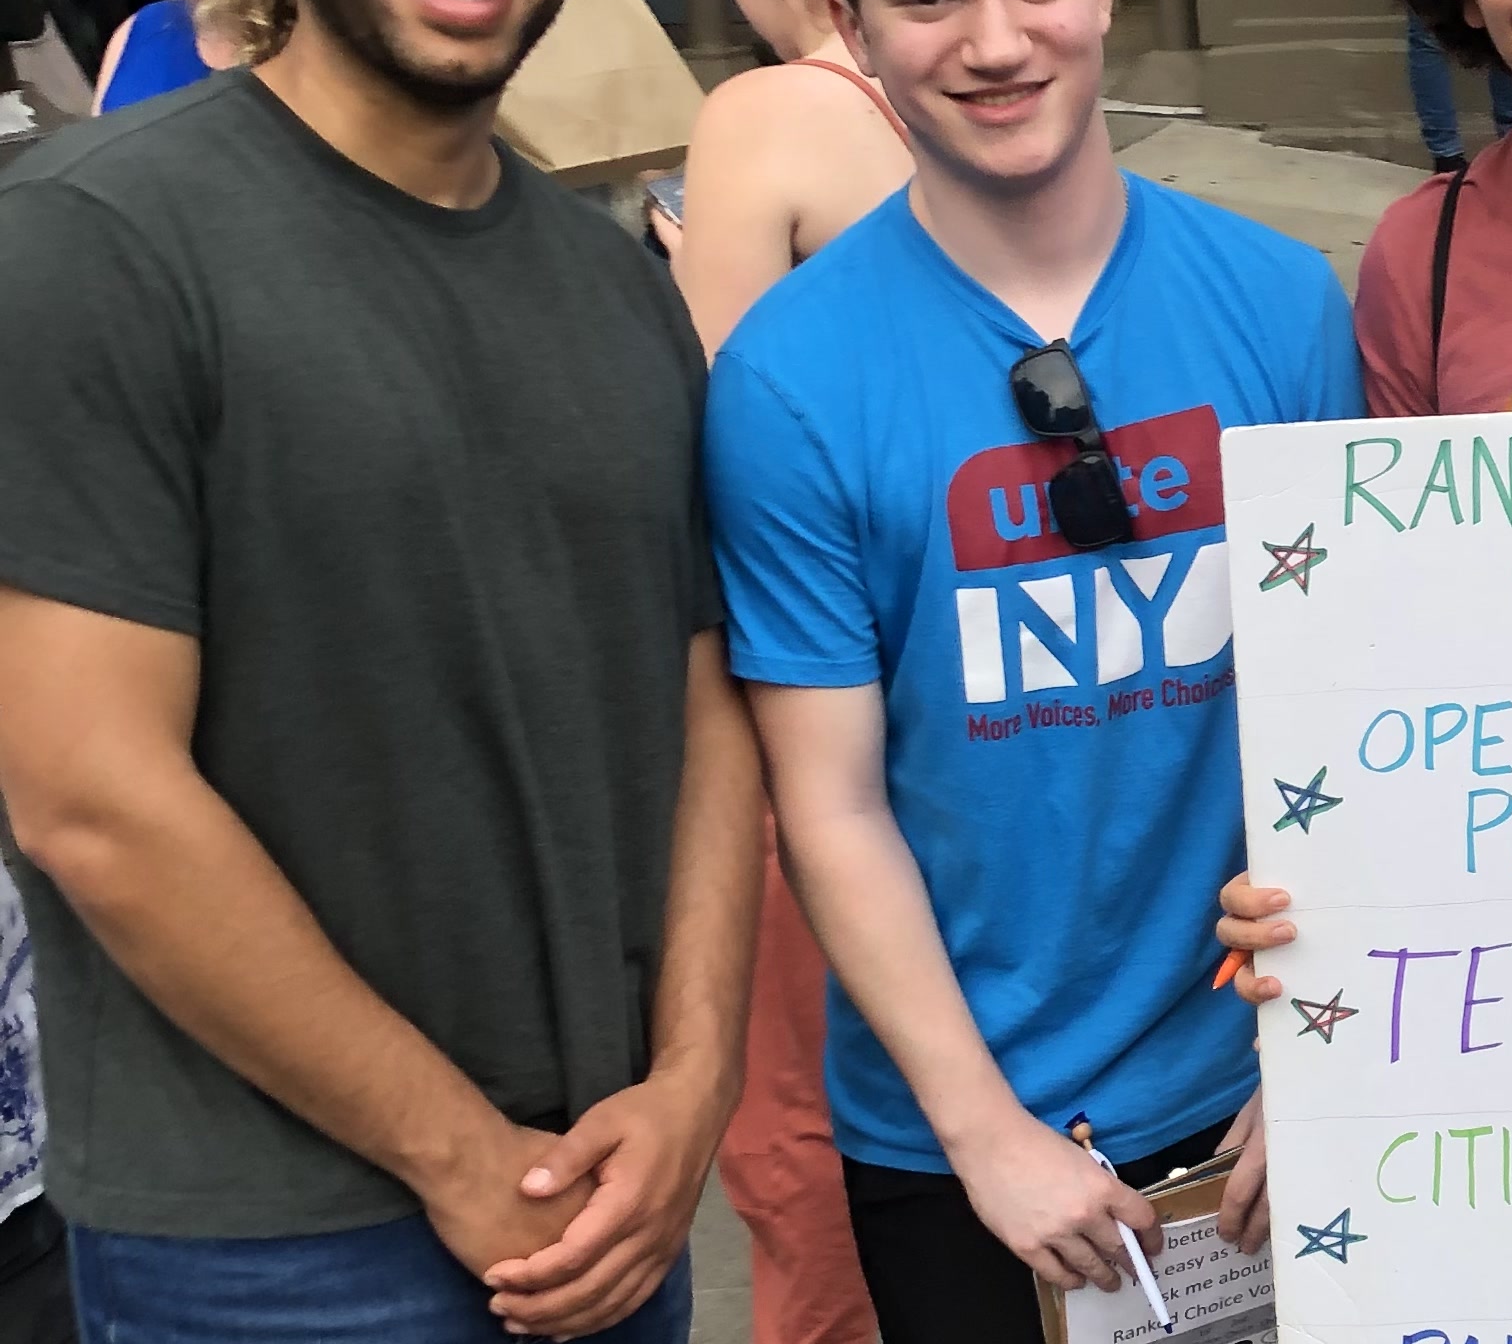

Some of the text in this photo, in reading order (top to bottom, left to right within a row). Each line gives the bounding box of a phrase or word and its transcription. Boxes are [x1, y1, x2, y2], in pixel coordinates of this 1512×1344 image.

[989, 453, 1190, 542] ute
[967, 667, 1236, 742] More Voices, More Choic
[1164, 1255, 1204, 1276] easy
[1209, 1247, 1229, 1262] as
[1185, 1278, 1213, 1296] me
[1218, 1258, 1270, 1285] about
[1184, 1292, 1244, 1320] Choice
